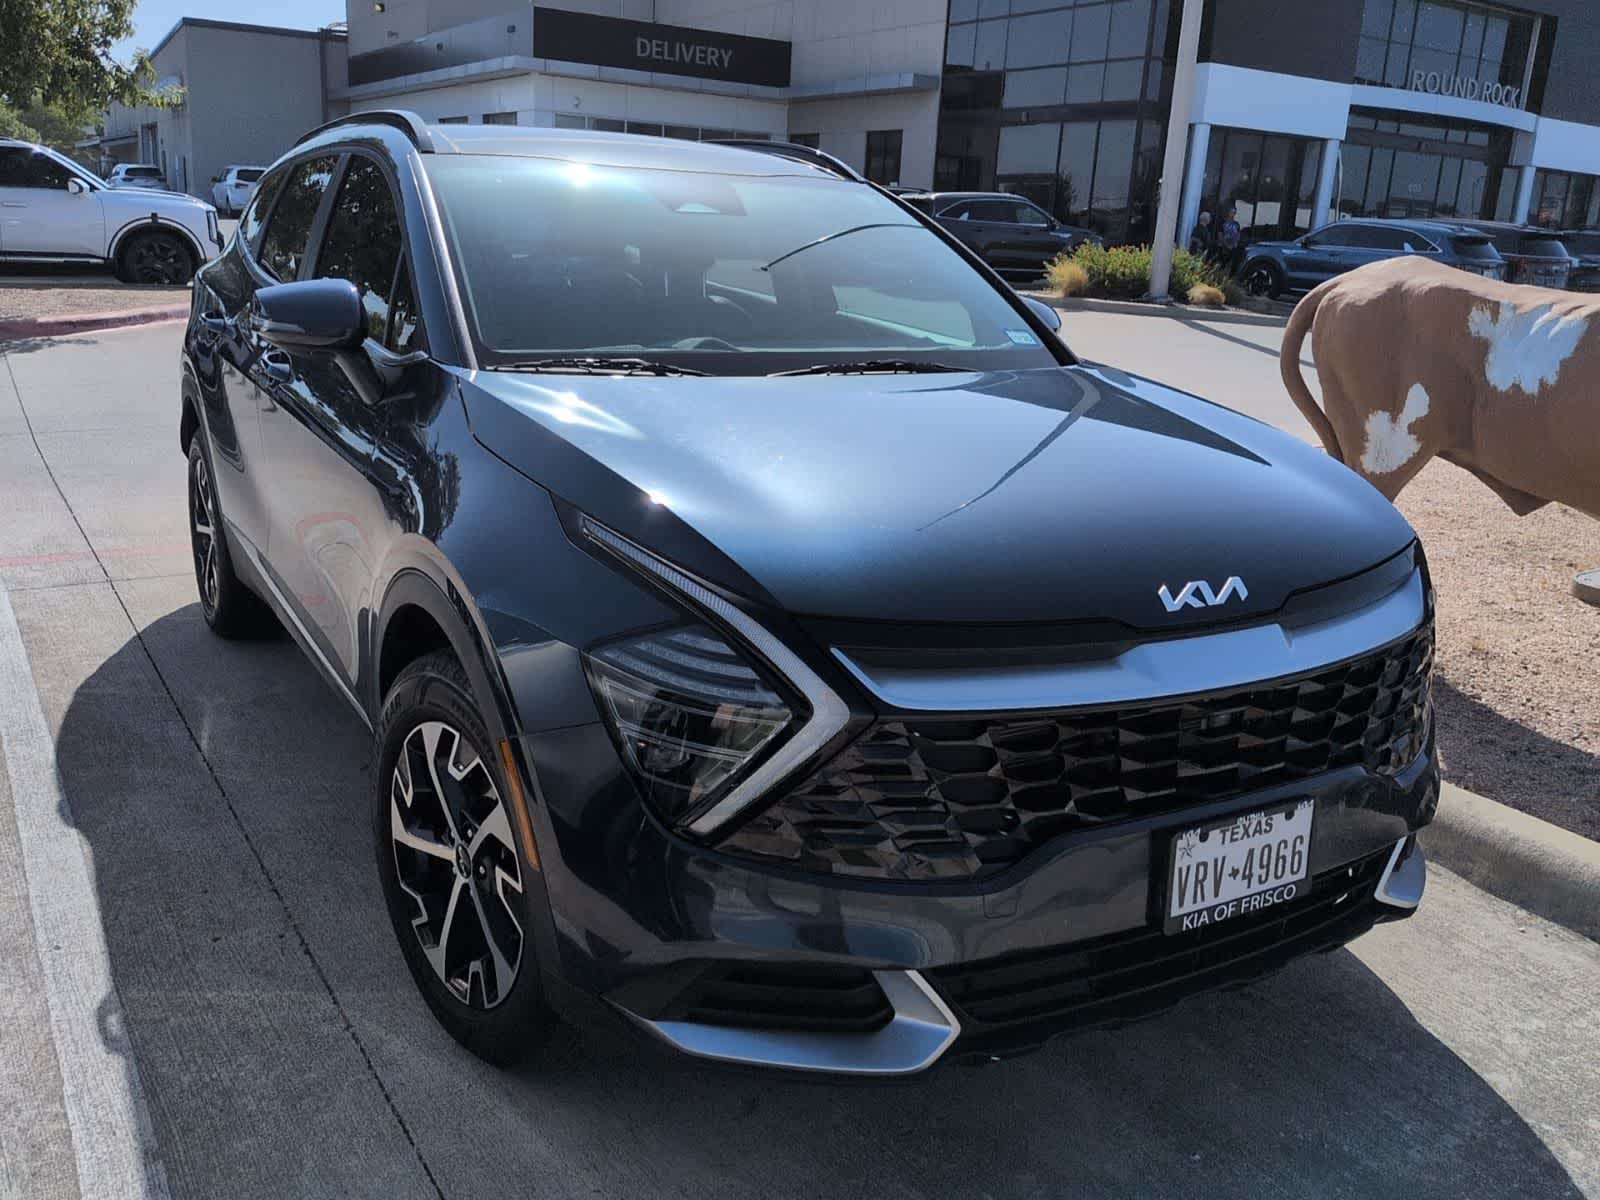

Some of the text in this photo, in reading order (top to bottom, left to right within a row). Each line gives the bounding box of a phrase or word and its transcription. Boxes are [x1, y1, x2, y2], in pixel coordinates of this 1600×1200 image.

[635, 36, 733, 69] DELIVERY
[1412, 69, 1521, 109] ROUND ROCK
[1158, 576, 1249, 612] KIA
[1219, 817, 1274, 846] TEXAS
[1176, 834, 1305, 909] VRV 4966
[1182, 884, 1297, 932] KIA OF FRISCO
